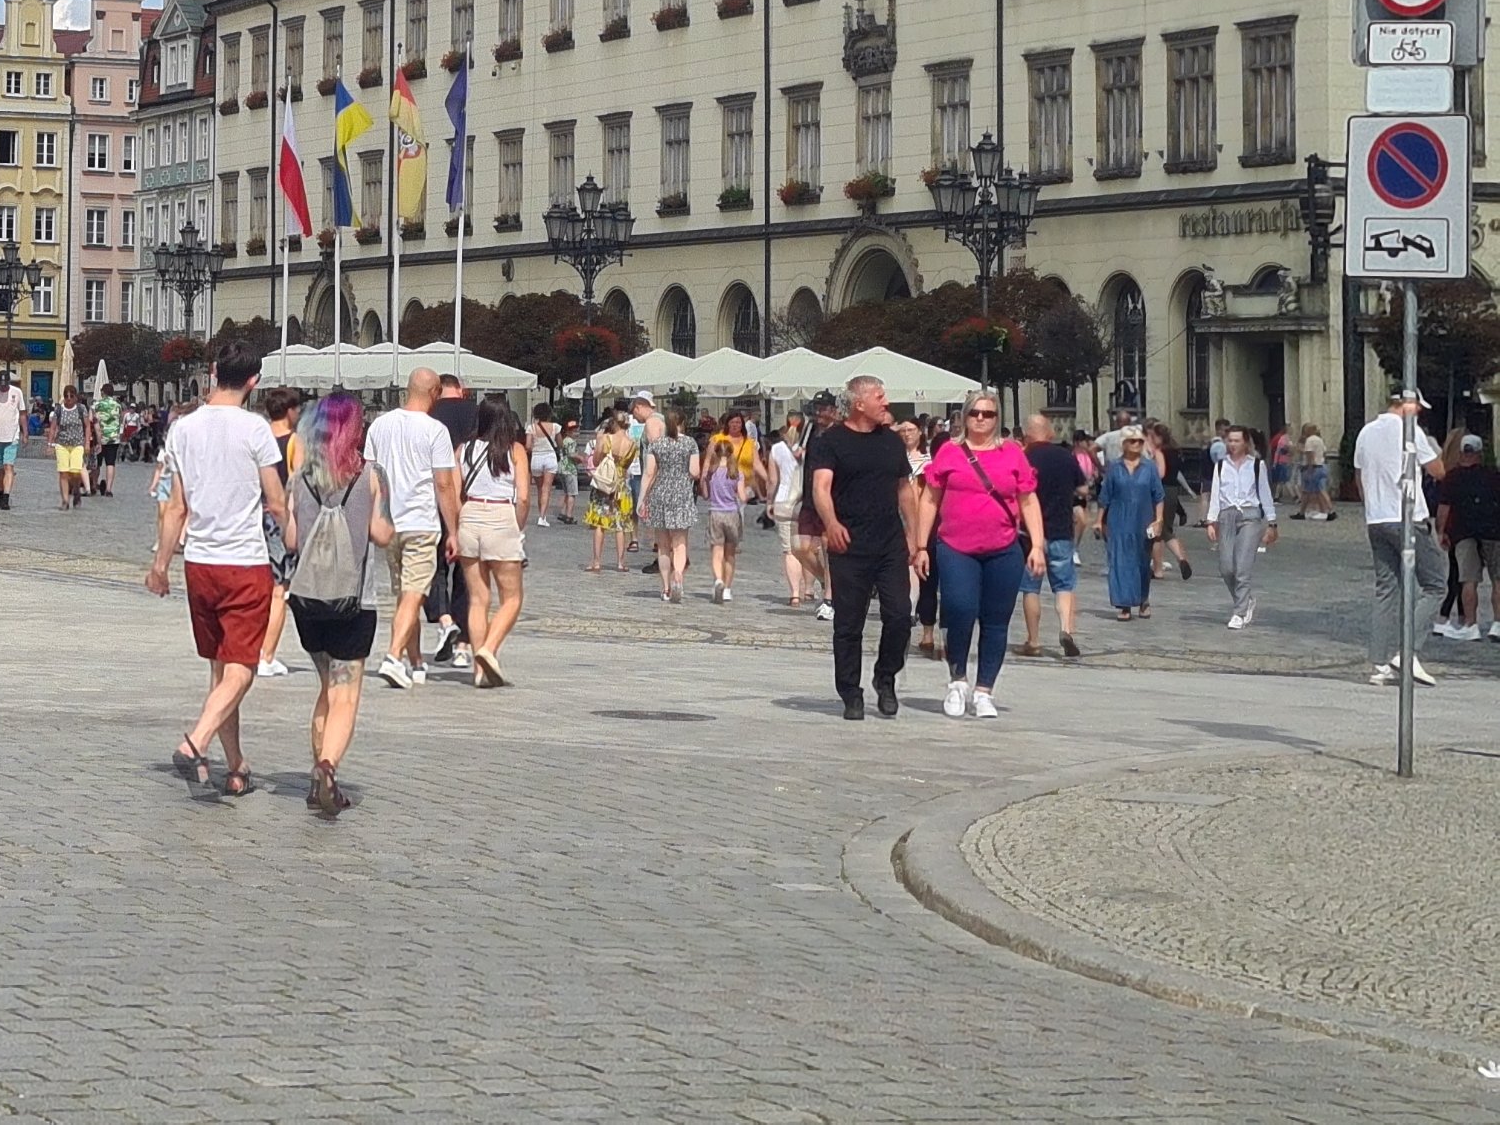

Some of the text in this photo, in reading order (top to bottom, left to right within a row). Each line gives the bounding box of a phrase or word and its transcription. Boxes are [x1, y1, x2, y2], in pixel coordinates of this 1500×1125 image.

[1379, 27, 1441, 38] Nie dotyczy
[1179, 199, 1299, 239] restauracja
